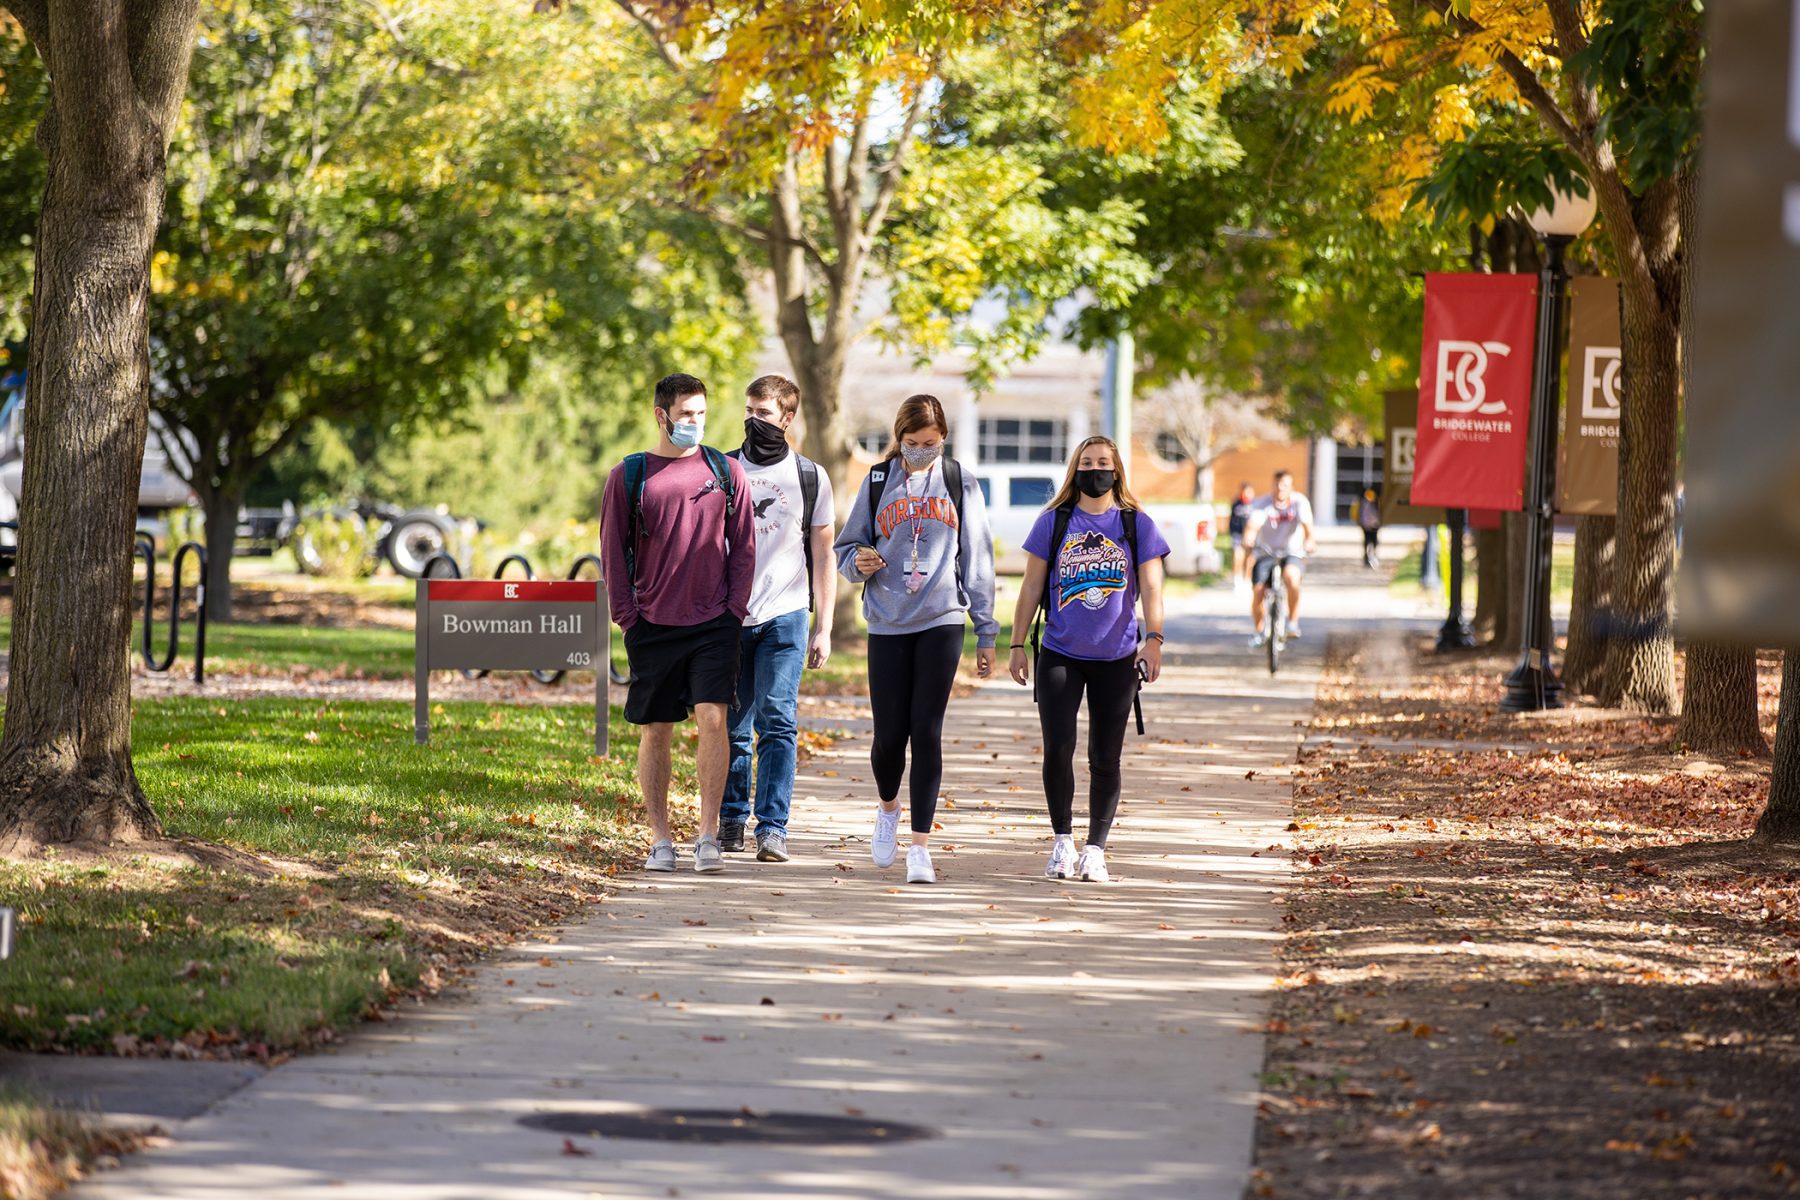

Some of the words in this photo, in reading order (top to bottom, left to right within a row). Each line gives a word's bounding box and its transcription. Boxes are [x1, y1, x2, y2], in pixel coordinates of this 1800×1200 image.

[1435, 339, 1512, 415] BC
[1433, 417, 1512, 433] BRIDGEWATER
[1451, 432, 1491, 442] COLLEGE
[1104, 547, 1124, 562] City
[1060, 560, 1126, 586] CLASSIC
[442, 614, 534, 634] Bowman
[539, 614, 582, 634] Hall
[566, 652, 591, 666] 403
